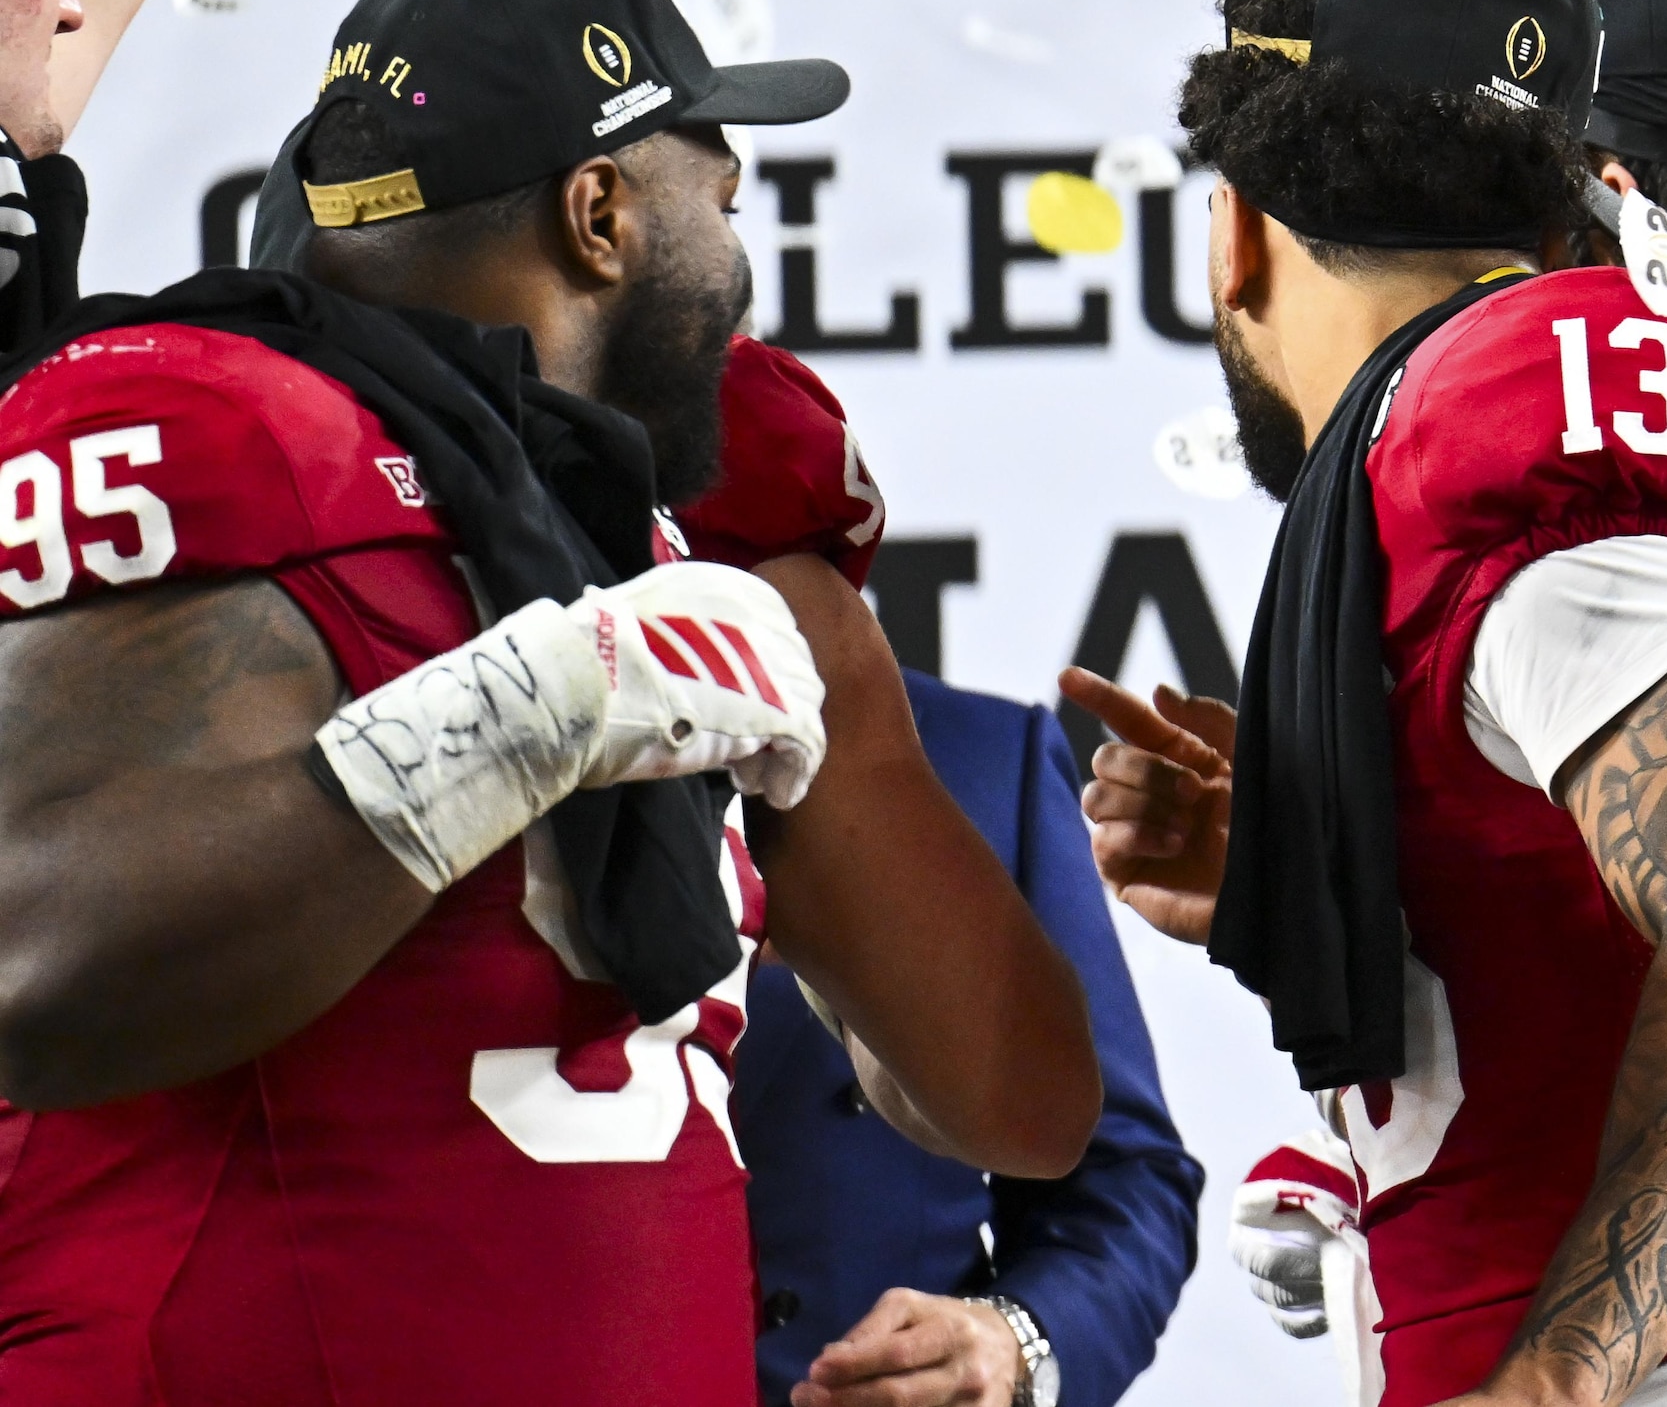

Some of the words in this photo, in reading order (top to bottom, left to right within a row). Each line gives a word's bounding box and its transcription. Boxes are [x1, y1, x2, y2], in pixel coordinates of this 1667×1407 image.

[379, 56, 412, 99] FL
[1491, 74, 1541, 110] NATIONAL
[600, 79, 659, 118] NATIONAL
[0, 424, 177, 609] 95
